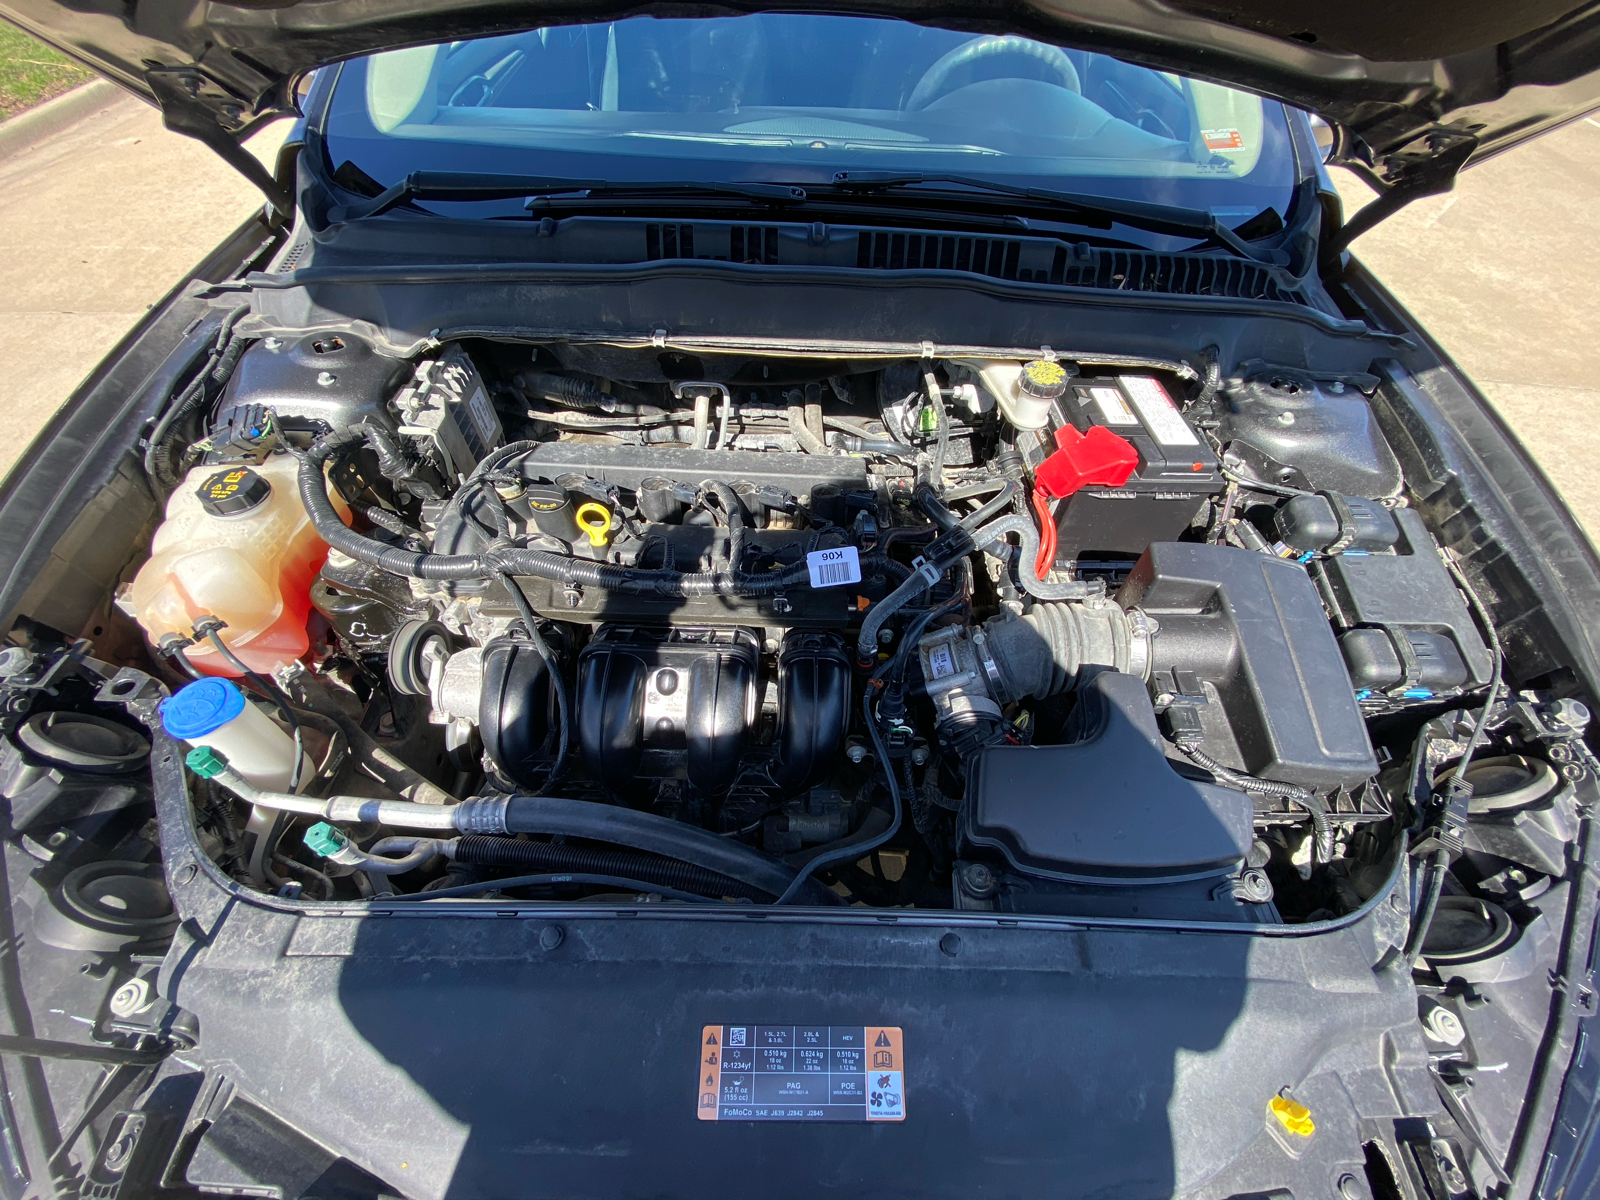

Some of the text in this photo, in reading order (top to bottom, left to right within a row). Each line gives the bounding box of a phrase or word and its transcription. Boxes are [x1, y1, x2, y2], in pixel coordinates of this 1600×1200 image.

[821, 550, 843, 561] K06
[780, 1050, 787, 1059] kg
[816, 1050, 824, 1059] kg
[852, 1051, 859, 1059] kg
[723, 1062, 751, 1071] R-1234yf
[841, 1082, 856, 1090] POE
[724, 1094, 748, 1102] (155 cc)
[724, 1108, 753, 1116] FoMoCo
